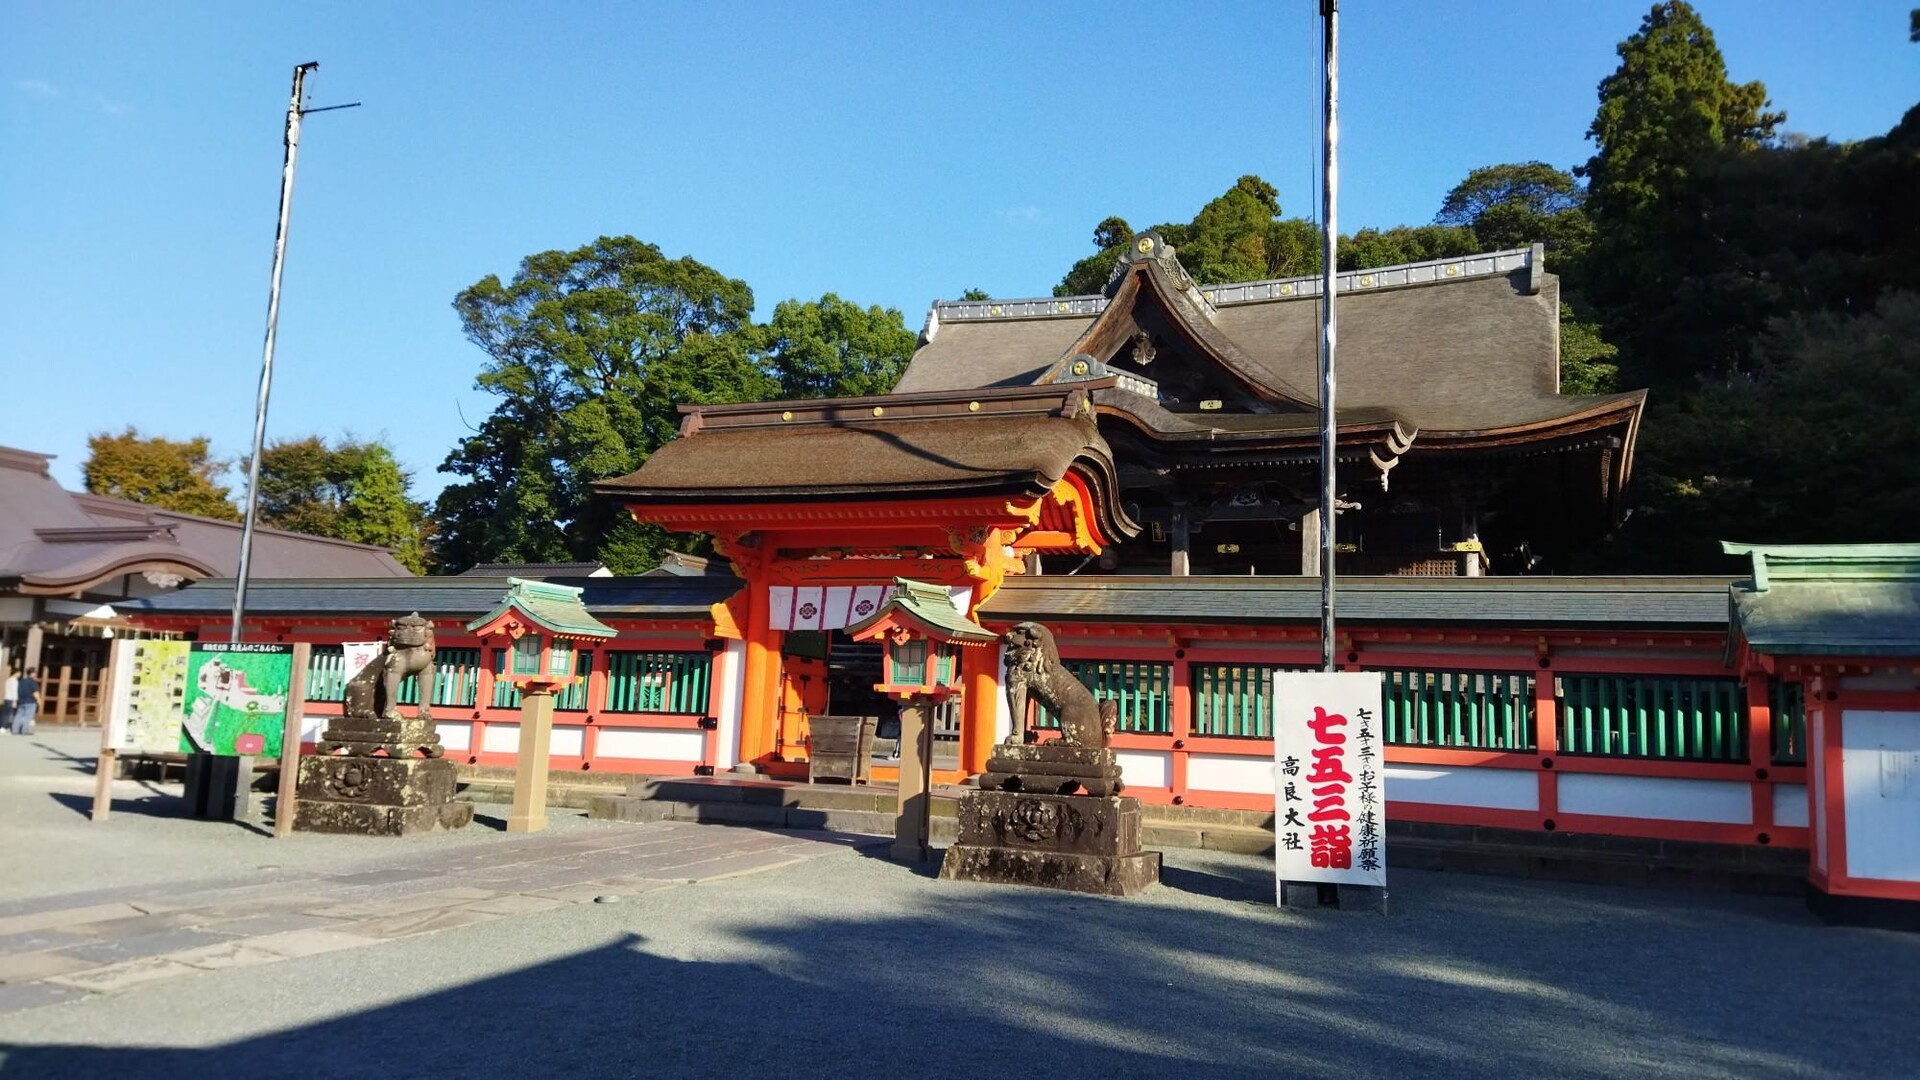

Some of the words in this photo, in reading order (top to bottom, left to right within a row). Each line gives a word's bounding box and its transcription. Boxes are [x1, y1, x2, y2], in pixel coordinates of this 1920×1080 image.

[1281, 756, 1305, 850] 高良大社
[1306, 706, 1353, 870] 七五三詣
